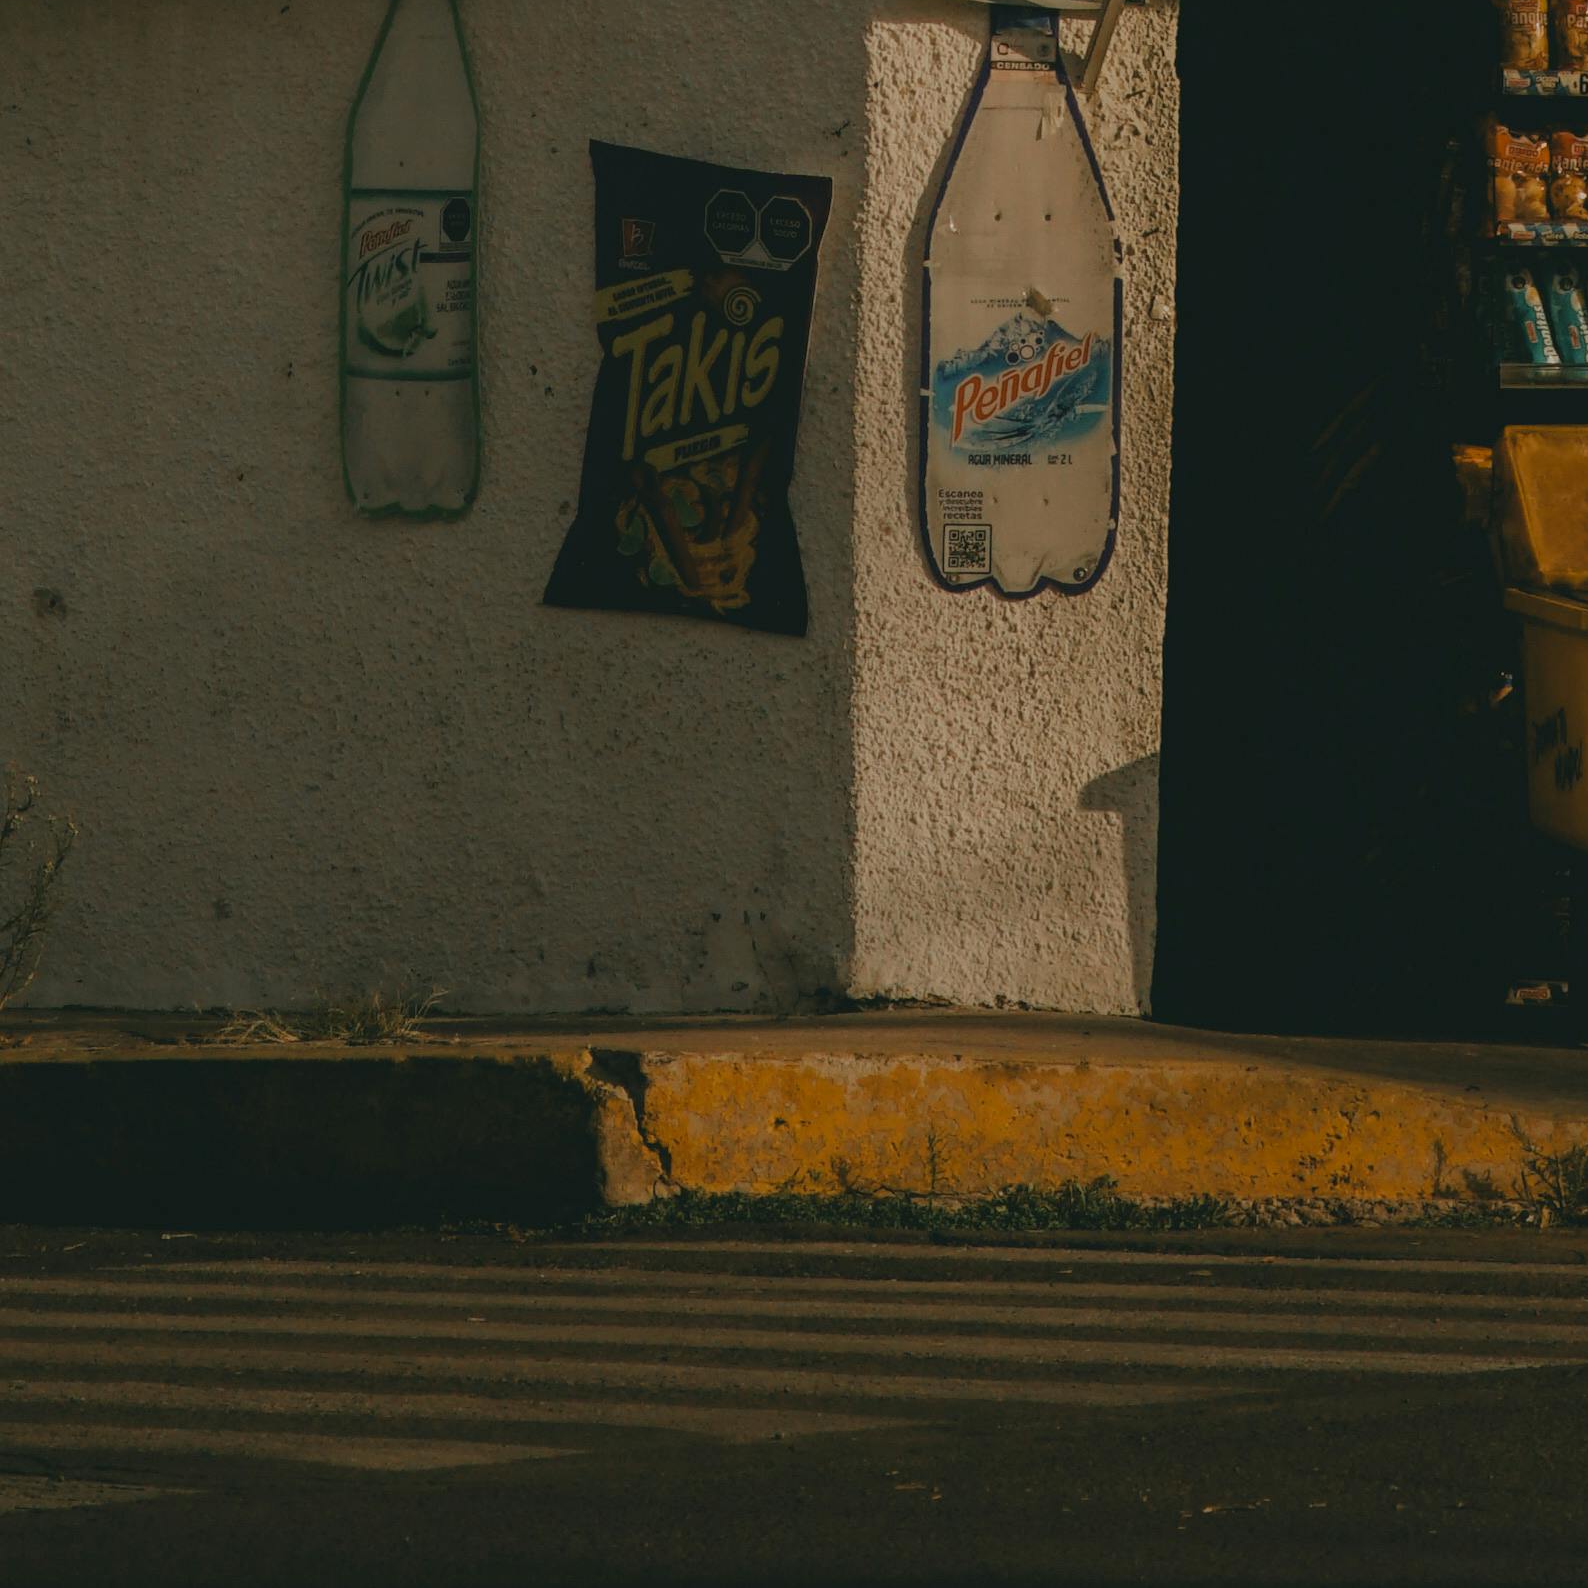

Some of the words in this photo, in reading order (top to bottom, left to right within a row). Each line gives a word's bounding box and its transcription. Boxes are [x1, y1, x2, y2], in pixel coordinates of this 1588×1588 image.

[952, 331, 1094, 442] Peñafiel
[967, 453, 992, 466] AGUA
[993, 453, 1033, 466] MINERAL
[938, 488, 984, 499] Escanea
[943, 512, 983, 520] recetas
